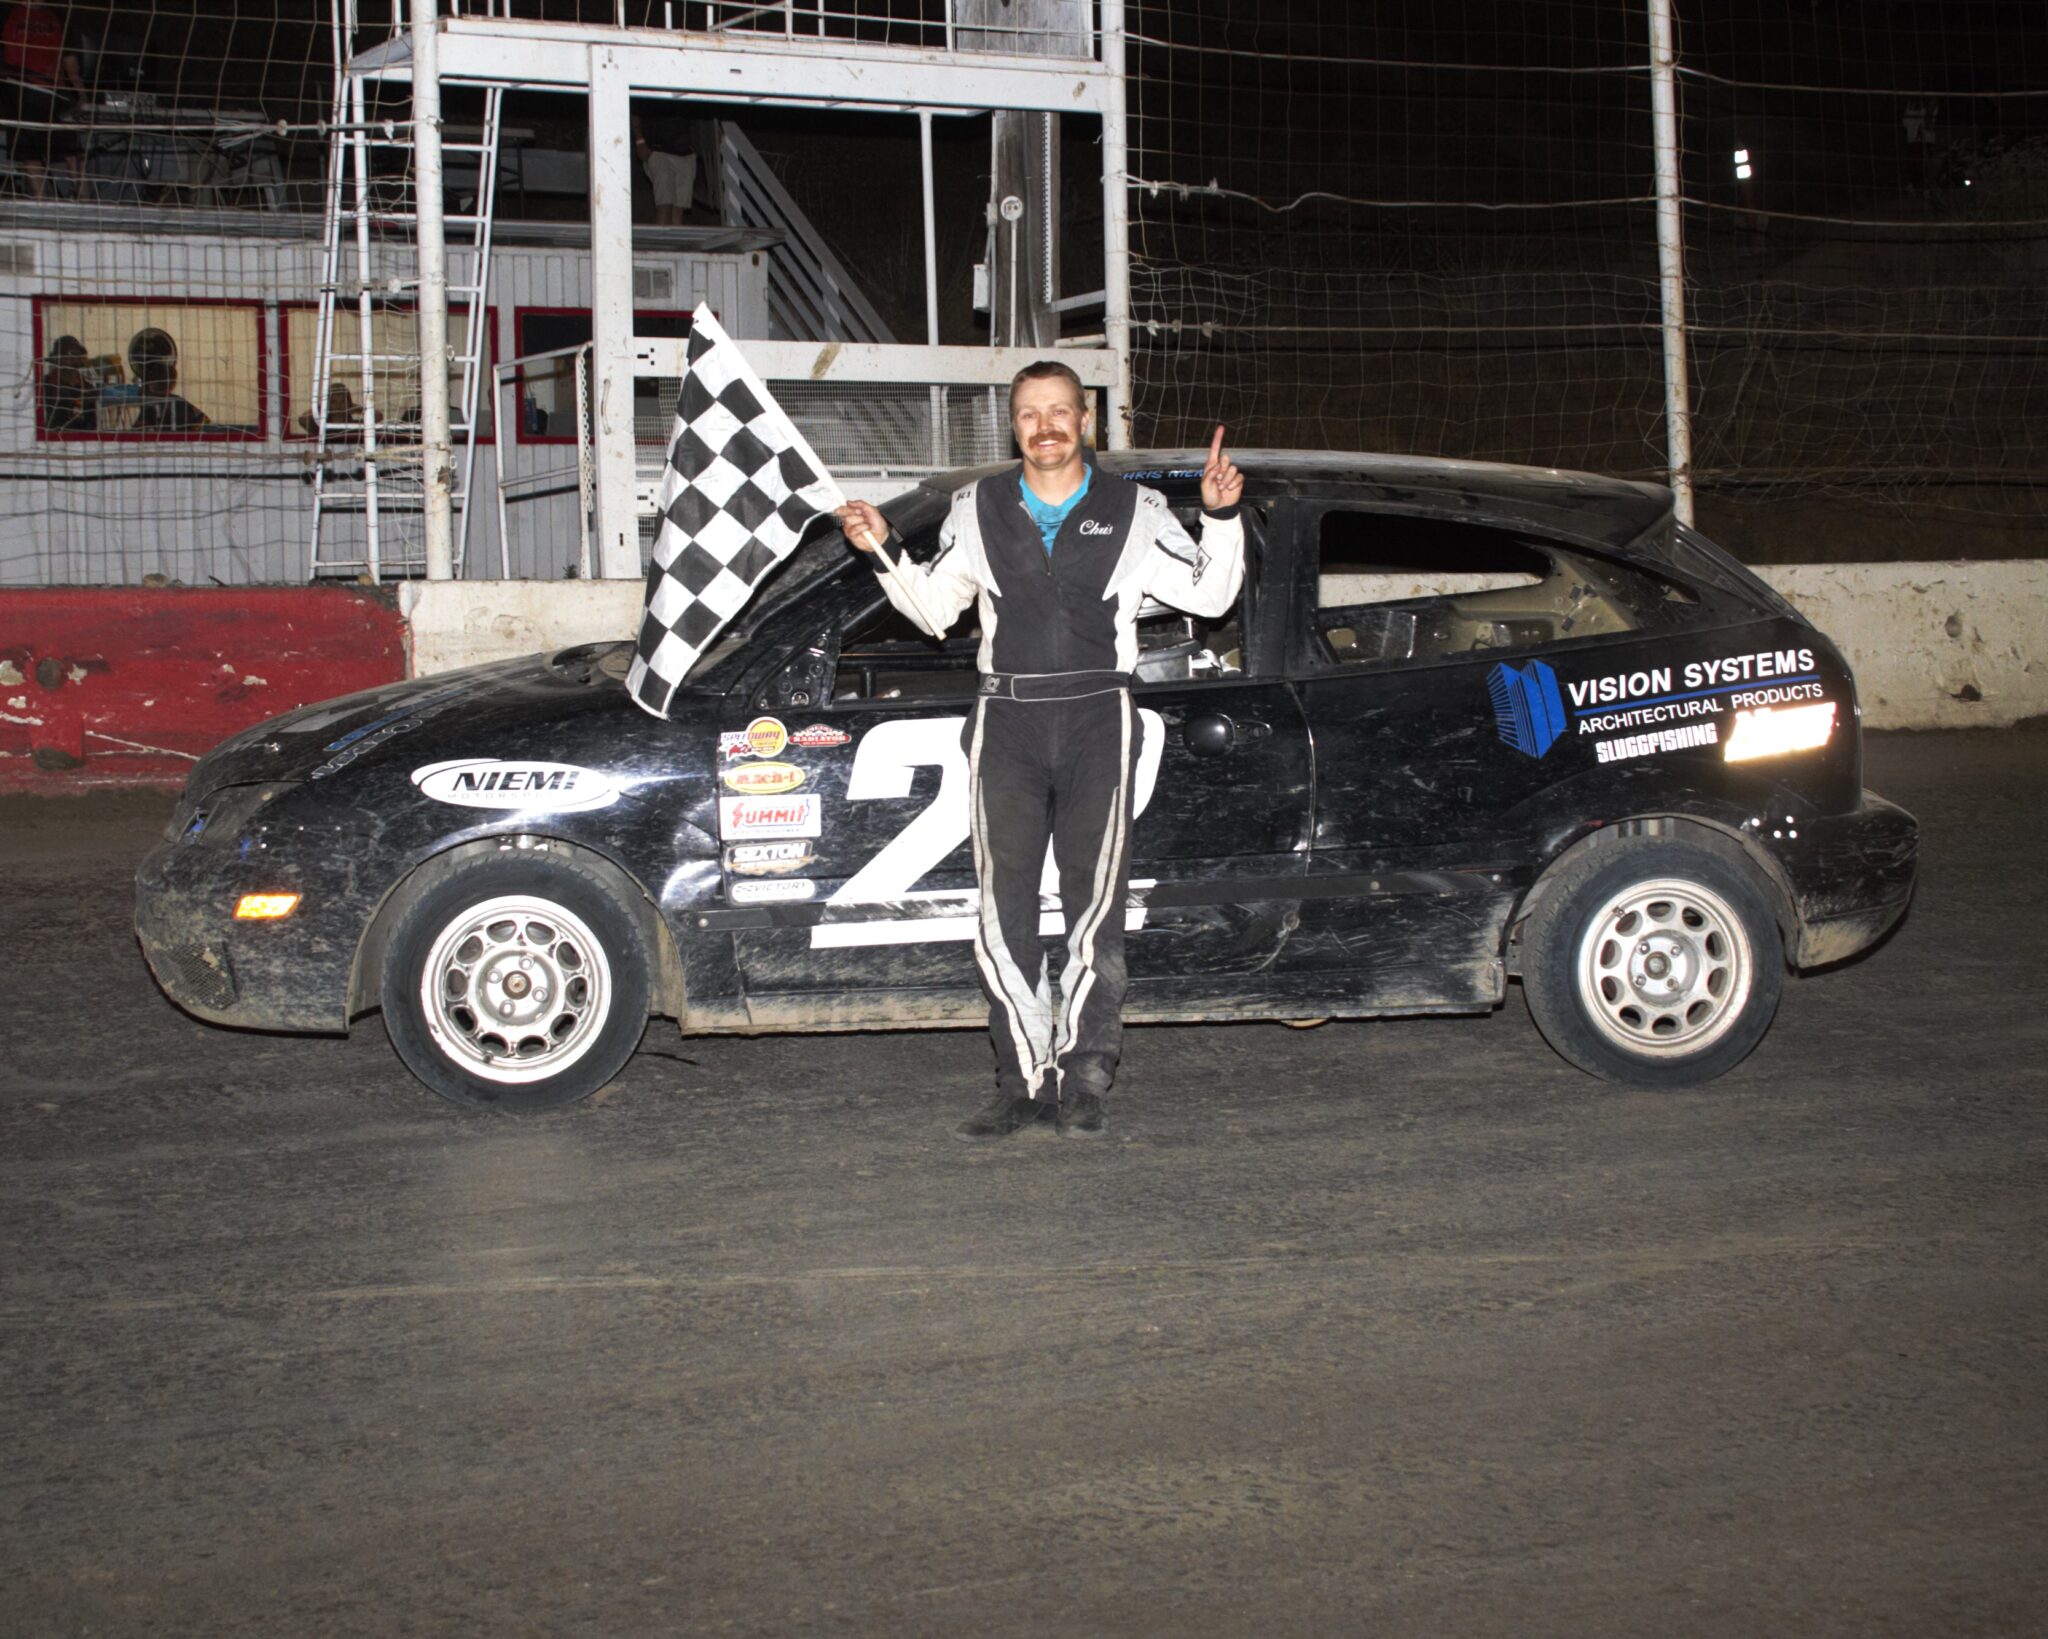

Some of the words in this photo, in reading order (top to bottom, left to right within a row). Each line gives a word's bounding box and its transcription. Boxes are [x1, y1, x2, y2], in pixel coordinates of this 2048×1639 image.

[1114, 471, 1162, 480] HRIS
[1079, 519, 1113, 536] Chris
[1568, 667, 1671, 706] VISION
[1684, 648, 1815, 687] SYSTEMS
[1578, 697, 1723, 735] ARCHITECTURAL
[1731, 683, 1823, 709] PRODUCTS
[1595, 722, 1718, 763] SLUGGFISHING
[733, 843, 806, 862] SEXTON
